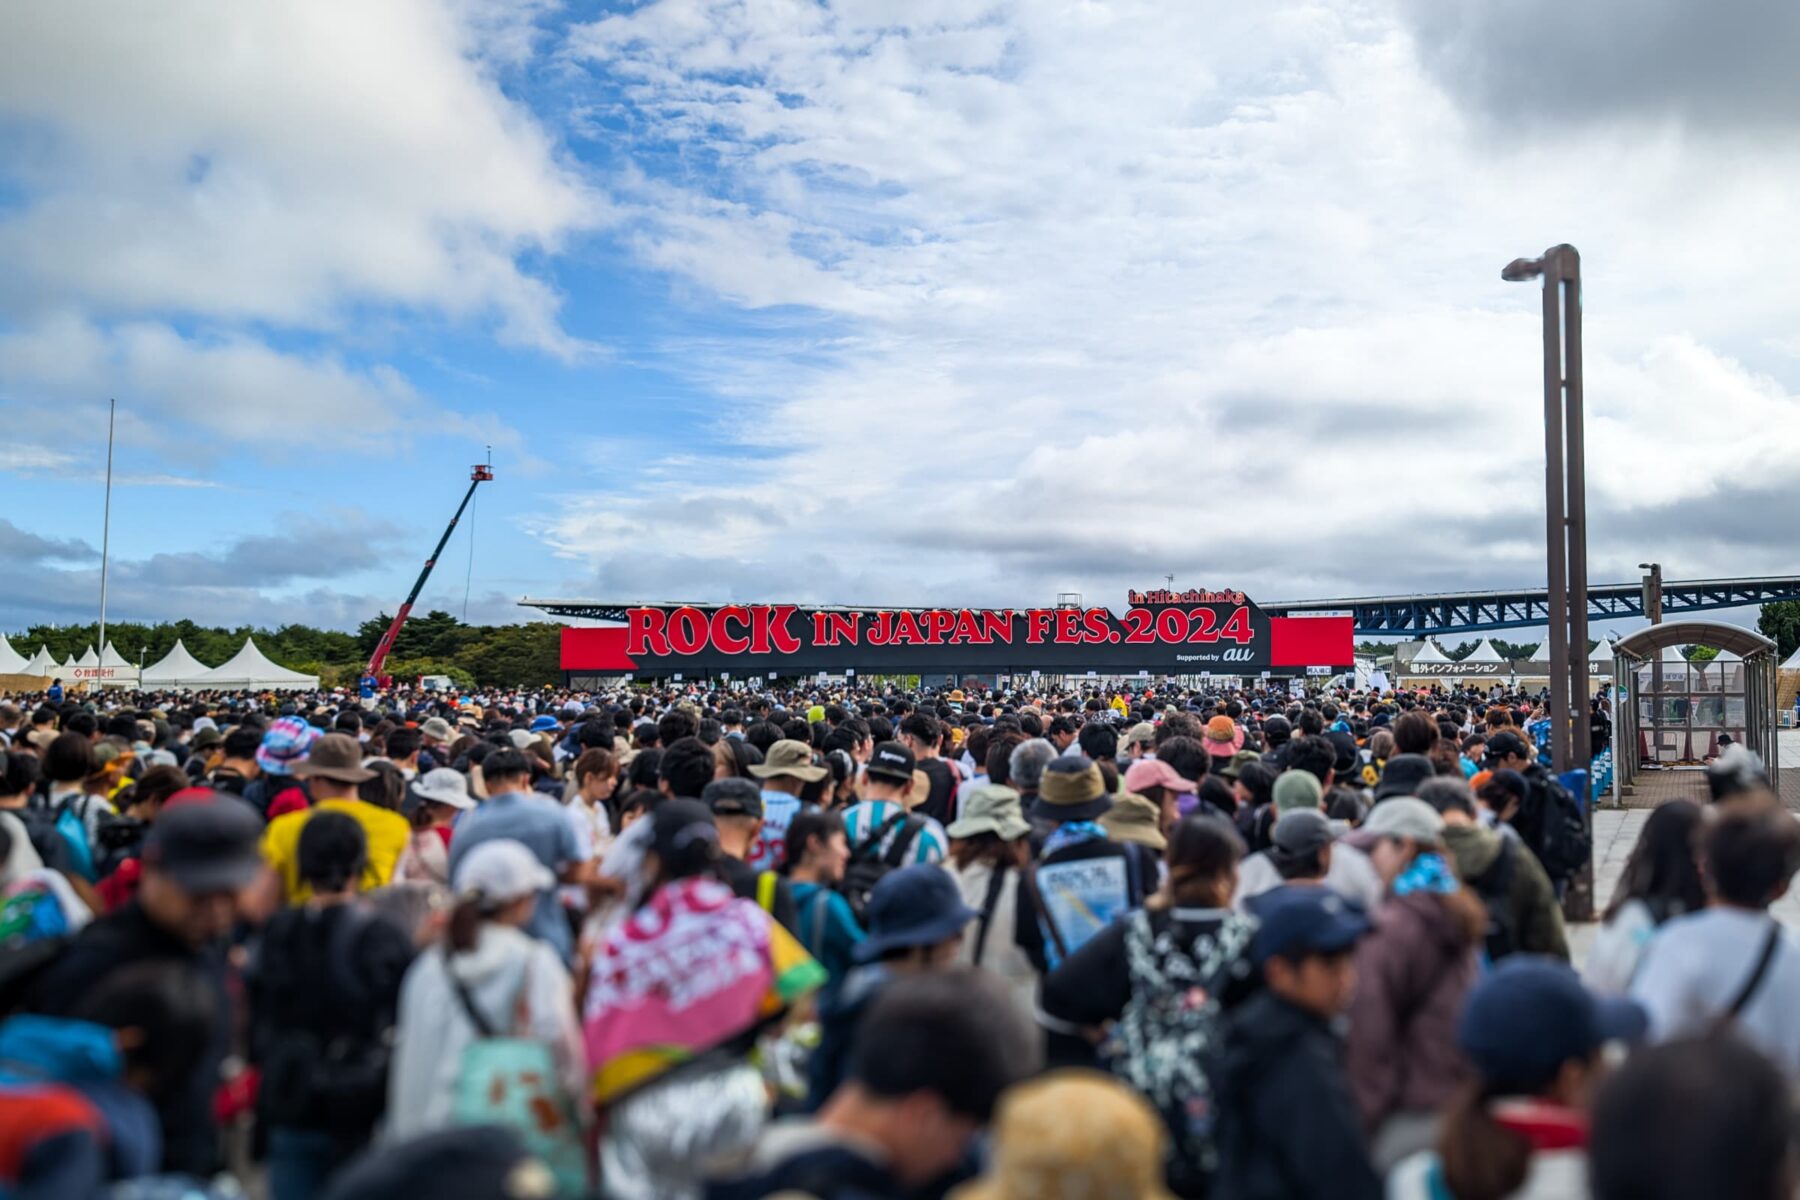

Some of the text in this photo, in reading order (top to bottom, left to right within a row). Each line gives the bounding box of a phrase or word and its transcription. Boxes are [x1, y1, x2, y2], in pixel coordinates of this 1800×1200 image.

[1129, 588, 1245, 605] in Hitachinaka
[627, 605, 801, 656] ROCK
[813, 611, 860, 646] IN
[867, 610, 1013, 646] JAPAN
[1176, 648, 1254, 662] Supported by au
[1410, 663, 1498, 673] 場外インフォメーション
